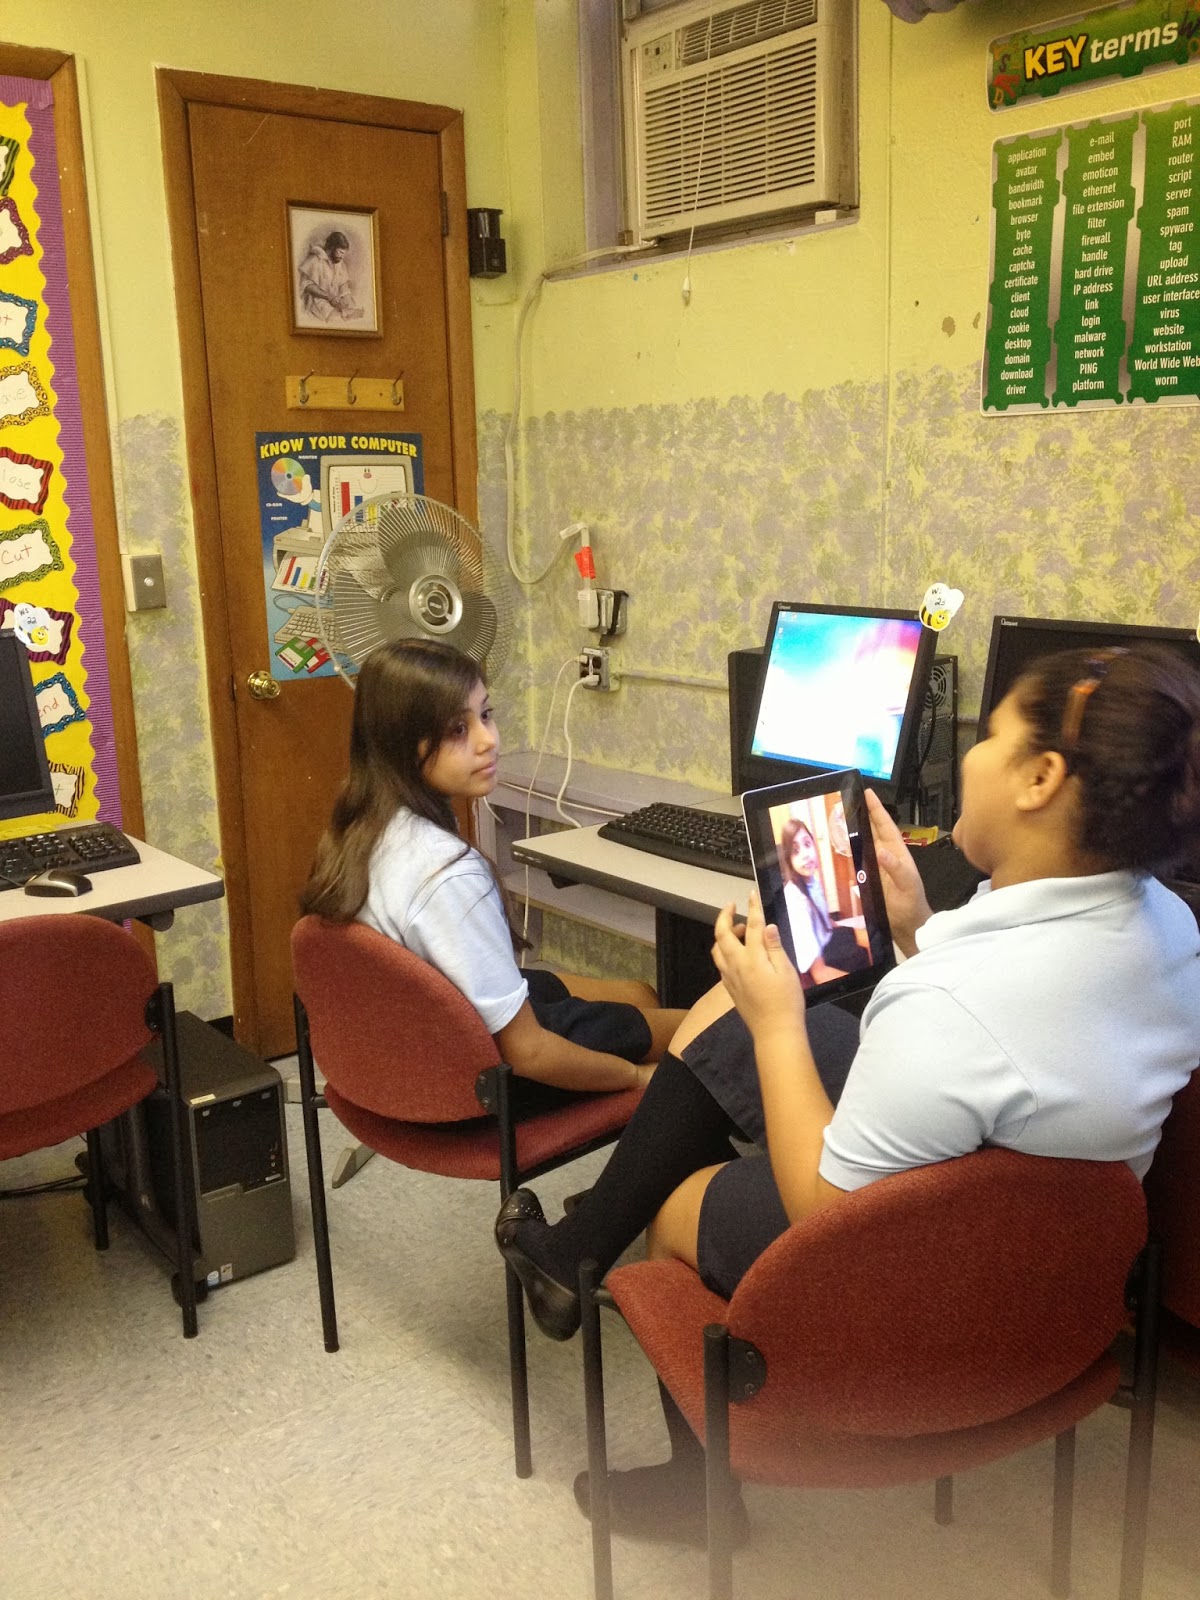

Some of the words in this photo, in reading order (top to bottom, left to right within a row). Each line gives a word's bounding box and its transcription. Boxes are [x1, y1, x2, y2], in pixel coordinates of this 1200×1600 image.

[1024, 34, 1089, 80] KEY
[1090, 21, 1179, 63] terms
[1174, 117, 1192, 130] port
[1090, 132, 1114, 146] e-mail
[1172, 134, 1192, 148] RAM
[1008, 147, 1046, 164] application
[1088, 149, 1114, 163] embed
[1169, 153, 1194, 166] router
[1016, 164, 1037, 178] avatar
[1083, 166, 1118, 181] emoticon
[1169, 170, 1192, 183] script
[1008, 179, 1044, 194] bandwidth
[1083, 183, 1116, 197] ethernet
[1166, 188, 1192, 201] server
[1009, 195, 1042, 210] bookmark
[1073, 203, 1084, 215] file
[1087, 199, 1124, 213] extension
[1167, 206, 1189, 218] spam
[1011, 212, 1038, 226] browser
[1088, 217, 1106, 229] filter
[1016, 229, 1031, 241] byte
[1160, 222, 1194, 236] spyware
[1082, 232, 1111, 246] firewall
[1013, 244, 1032, 256] cache
[1169, 239, 1182, 253] tag
[1082, 250, 1108, 262] handle
[1160, 255, 1188, 270] upload
[1009, 259, 1035, 273] captcha
[1075, 267, 1091, 279] hard
[1094, 266, 1113, 277] drive
[1005, 274, 1038, 288] certificate
[1147, 275, 1162, 287] URL
[1165, 272, 1199, 285] address
[1074, 284, 1081, 295] IP
[1083, 283, 1113, 294] address
[1011, 291, 1030, 303] client
[1143, 293, 1160, 304] user
[1163, 289, 1200, 302] interface
[1085, 299, 1099, 310] link
[1010, 306, 1029, 318] cloud
[1160, 307, 1180, 319] virus
[1008, 322, 1029, 334] cookie
[1082, 315, 1100, 328] login
[1153, 324, 1185, 336] website
[1074, 331, 1106, 343] malware
[1005, 338, 1031, 351] desktop
[1145, 340, 1191, 353] workstation
[1005, 353, 1030, 365] domain
[1075, 347, 1104, 359] network
[1080, 362, 1097, 375] PING
[1135, 358, 1158, 371] World
[1160, 357, 1180, 369] Wide
[1183, 356, 1200, 367] Web
[1001, 368, 1033, 381] download
[1155, 375, 1178, 385] worm
[1006, 384, 1026, 395] driver
[1072, 379, 1104, 393] platform
[260, 438, 304, 459] KNOW
[309, 436, 346, 449] YOUR
[351, 436, 417, 457] COMPUTER
[2, 544, 32, 564] Cut
